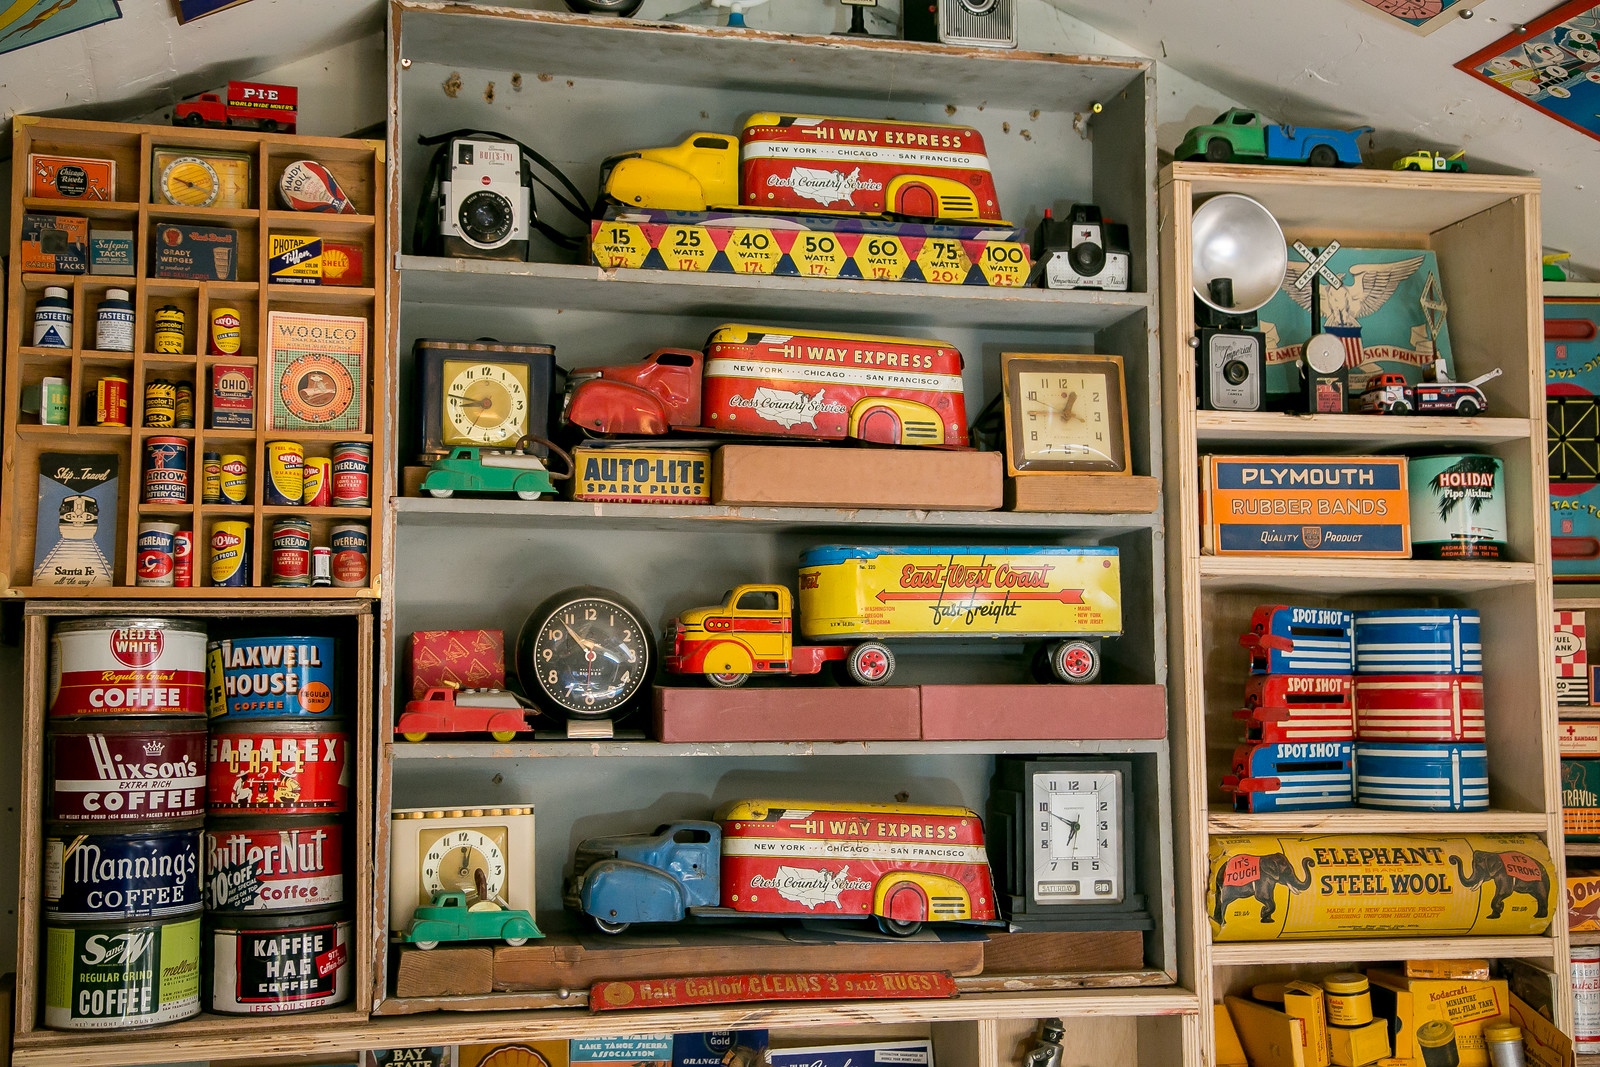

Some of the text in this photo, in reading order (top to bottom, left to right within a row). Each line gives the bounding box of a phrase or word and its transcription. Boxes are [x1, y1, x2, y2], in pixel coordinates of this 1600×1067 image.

[838, 129, 879, 143] WAY
[885, 131, 962, 148] EXPRESS
[837, 149, 878, 157] CHICAGO
[919, 154, 970, 163] FRANCISCO
[285, 164, 303, 191] HANDY
[294, 174, 310, 192] ROLL
[766, 174, 882, 191] Cross Country Service
[33, 222, 79, 231] FULVIEW
[611, 228, 631, 245] 15
[675, 230, 701, 247] 25
[739, 234, 769, 250] 40
[96, 241, 129, 252] Safepin
[604, 245, 636, 253] WATTS
[805, 236, 835, 252] 50
[868, 240, 898, 256] 60
[933, 243, 957, 259] 75
[163, 249, 190, 257] GRADY
[672, 249, 704, 257] WATTS
[804, 254, 835, 262] WATTS
[985, 246, 1023, 264] 100
[59, 262, 85, 270] TACKS
[160, 256, 193, 265] WEDGES
[322, 259, 346, 267] SHELL
[930, 261, 960, 269] WATTS
[1296, 243, 1341, 286] RAIL ROAD
[1296, 243, 1338, 287] CROSSING
[989, 265, 1019, 273] WATTS
[35, 312, 72, 322] FASTEETH
[99, 312, 135, 322] FASTEETH
[278, 324, 357, 341] WOOLCO
[807, 346, 847, 363] WAY
[854, 350, 933, 369] EXPRESS
[1363, 349, 1389, 360] SIGN
[758, 366, 783, 374] YORK
[803, 369, 845, 378] CHICAGO
[221, 379, 246, 391] OHIO
[887, 376, 939, 385] FRANCISCO
[729, 395, 846, 413] Cross Country Service
[335, 463, 367, 471] EVEREADY
[584, 458, 705, 484] AUTO-LITE
[148, 472, 185, 482] ARROW
[1241, 468, 1374, 485] PLYMOUTH
[1439, 472, 1494, 488] HOLIDAY
[170, 491, 185, 499] CELL
[587, 483, 701, 495] SPARK PLUGS
[1444, 488, 1464, 499] Pipe
[1231, 499, 1388, 516] RUBBER BANDS
[274, 538, 307, 547] EVEREADY
[54, 566, 95, 576] Santa Fe
[900, 564, 1055, 589] East-West Coast
[929, 600, 1022, 625] fast freight
[1292, 609, 1342, 625] SPOT SHOT
[119, 629, 157, 640] RED &
[115, 640, 158, 653] WHITE
[101, 671, 175, 684] Regular Grind
[225, 673, 298, 696] HOUSE
[1287, 678, 1342, 692] SPOT SHOT
[89, 688, 180, 708] COFFEE
[234, 702, 284, 711] COFFEE
[87, 733, 197, 780] Hixson's
[1277, 743, 1341, 758] SPOT SHOT
[230, 749, 305, 773] CAFE
[118, 780, 171, 790] EXTRA RICH
[83, 790, 196, 812] COFFEE
[830, 821, 871, 836] WAY
[878, 823, 957, 840] EXPRESS
[827, 845, 870, 853] CHICAGO
[890, 847, 965, 857] SAN FRANCISCO
[74, 843, 196, 885] Manning's
[1233, 857, 1250, 868] IT'S
[1312, 847, 1445, 867] ELEPHANT
[1510, 854, 1529, 865] IT'S
[1226, 866, 1258, 881] TOUGH
[1506, 862, 1541, 877] STRONG
[751, 875, 872, 891] Cross Country Service
[1320, 875, 1452, 895] STEEL WOOL
[87, 885, 184, 909] COFFEE
[260, 884, 318, 900] Coffee
[254, 935, 323, 957] KAFFEE
[267, 959, 312, 979] HAG
[80, 970, 153, 983] REGULAR GRIND
[259, 979, 319, 993] COFFEE
[639, 983, 677, 1000] Half
[685, 979, 742, 997] Gallon
[749, 975, 819, 995] CLEANS
[829, 975, 840, 992] 3
[884, 975, 941, 991] RUGS!
[1429, 985, 1469, 1002] Kodacraft
[1446, 994, 1477, 1007] MINIATURE
[79, 986, 151, 1016] COFFEE
[250, 999, 326, 1013] LETS YOU SLEEP
[1479, 999, 1494, 1010] TANK
[579, 1042, 667, 1050] LAKE TAHOE SIERRA
[710, 1036, 730, 1046] Gold
[393, 1048, 425, 1062] BAY
[683, 1056, 721, 1065] ORANGE
